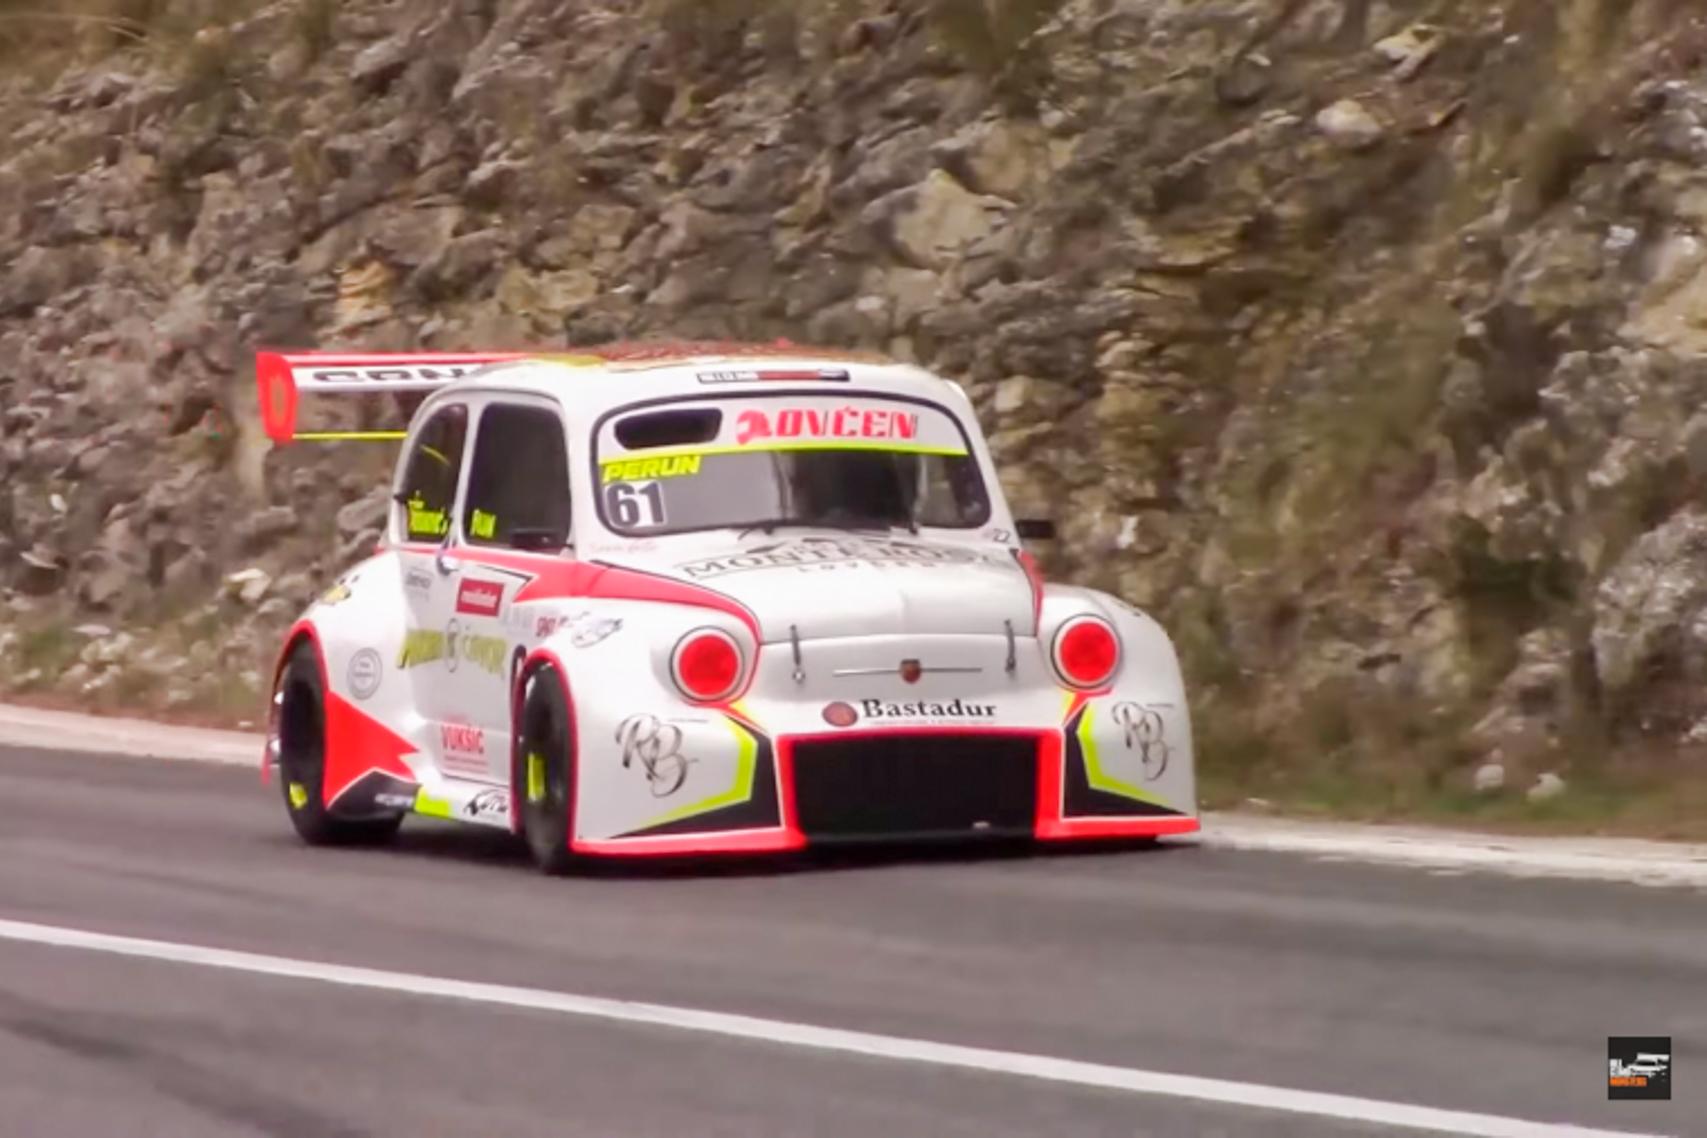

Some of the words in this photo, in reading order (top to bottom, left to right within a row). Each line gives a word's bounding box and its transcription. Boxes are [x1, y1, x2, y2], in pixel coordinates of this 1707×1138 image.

[602, 454, 701, 484] PERUN
[606, 481, 664, 528] 61
[859, 698, 997, 719] Bastadur
